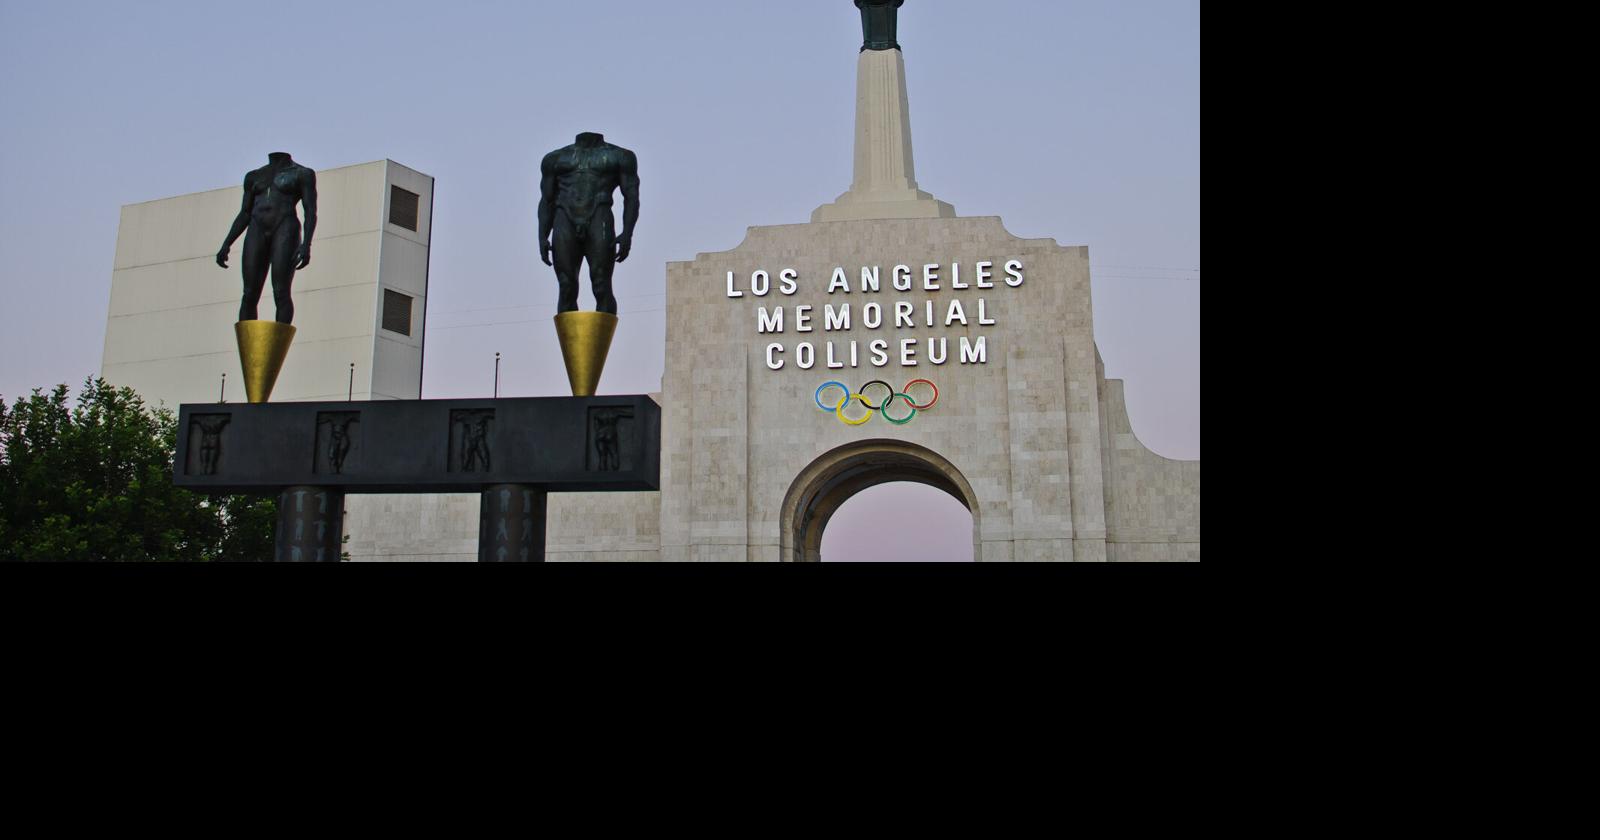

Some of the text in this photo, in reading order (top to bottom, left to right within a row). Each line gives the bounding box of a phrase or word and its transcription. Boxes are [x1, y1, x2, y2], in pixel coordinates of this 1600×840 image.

[727, 259, 1024, 297] LOS ANGELES
[758, 298, 995, 333] MEMORIAL
[766, 336, 986, 370] COLISEUM
